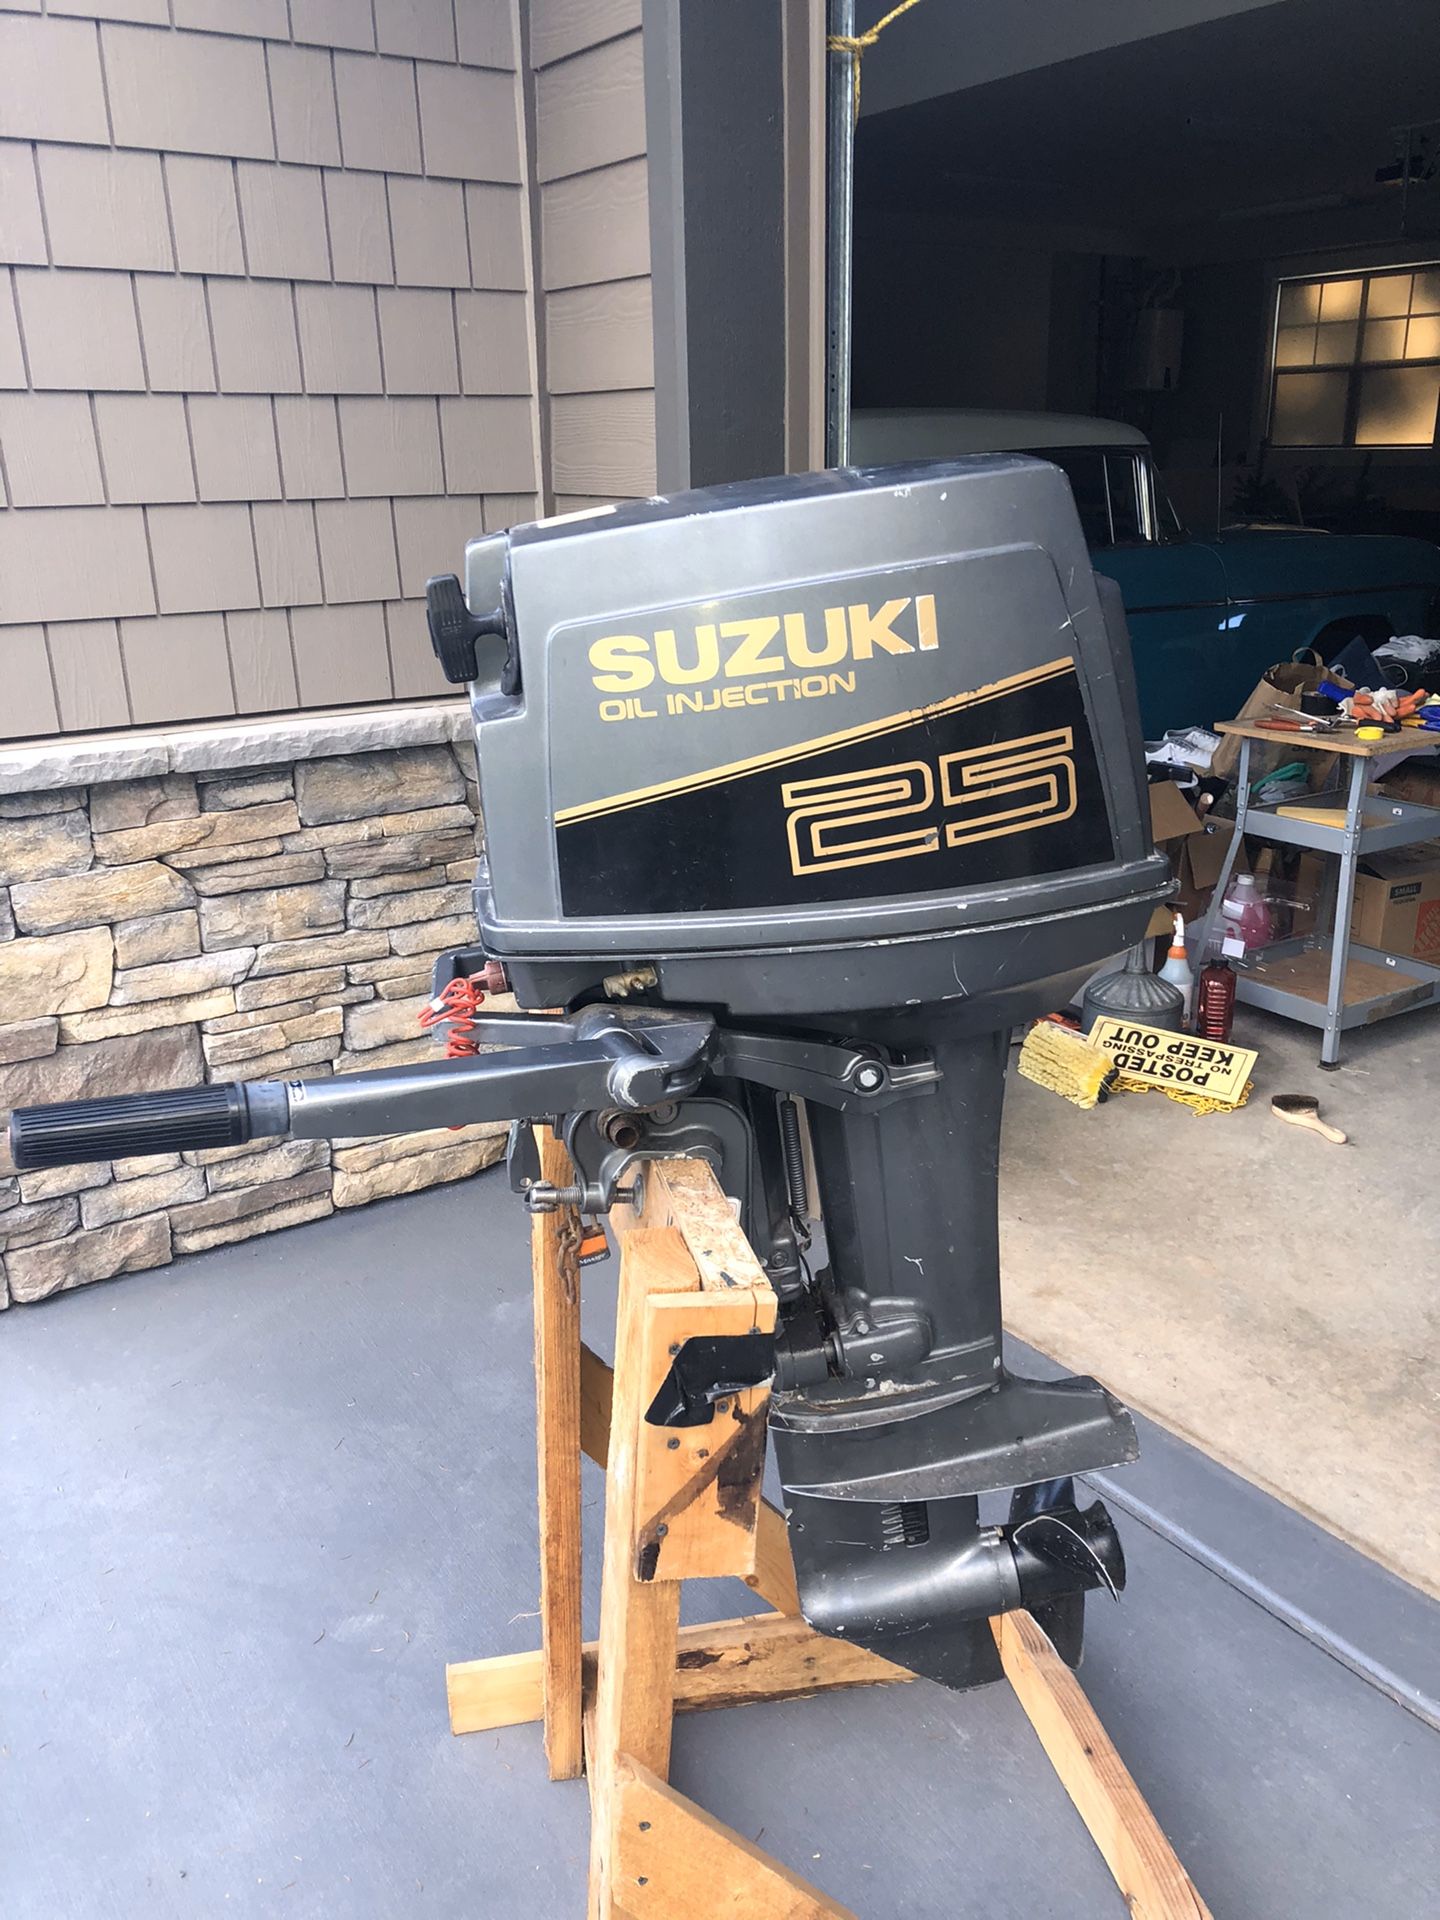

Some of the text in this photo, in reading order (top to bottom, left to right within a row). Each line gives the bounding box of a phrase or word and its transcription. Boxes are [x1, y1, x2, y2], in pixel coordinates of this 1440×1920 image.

[588, 593, 940, 693] SUZUKI
[598, 670, 856, 722] OIL INJECTION
[781, 726, 1077, 876] 25
[1102, 1040, 1232, 1076] NO TRESPASSING
[1109, 1027, 1234, 1067] KEEP OUT
[1113, 1053, 1211, 1087] POSTED
